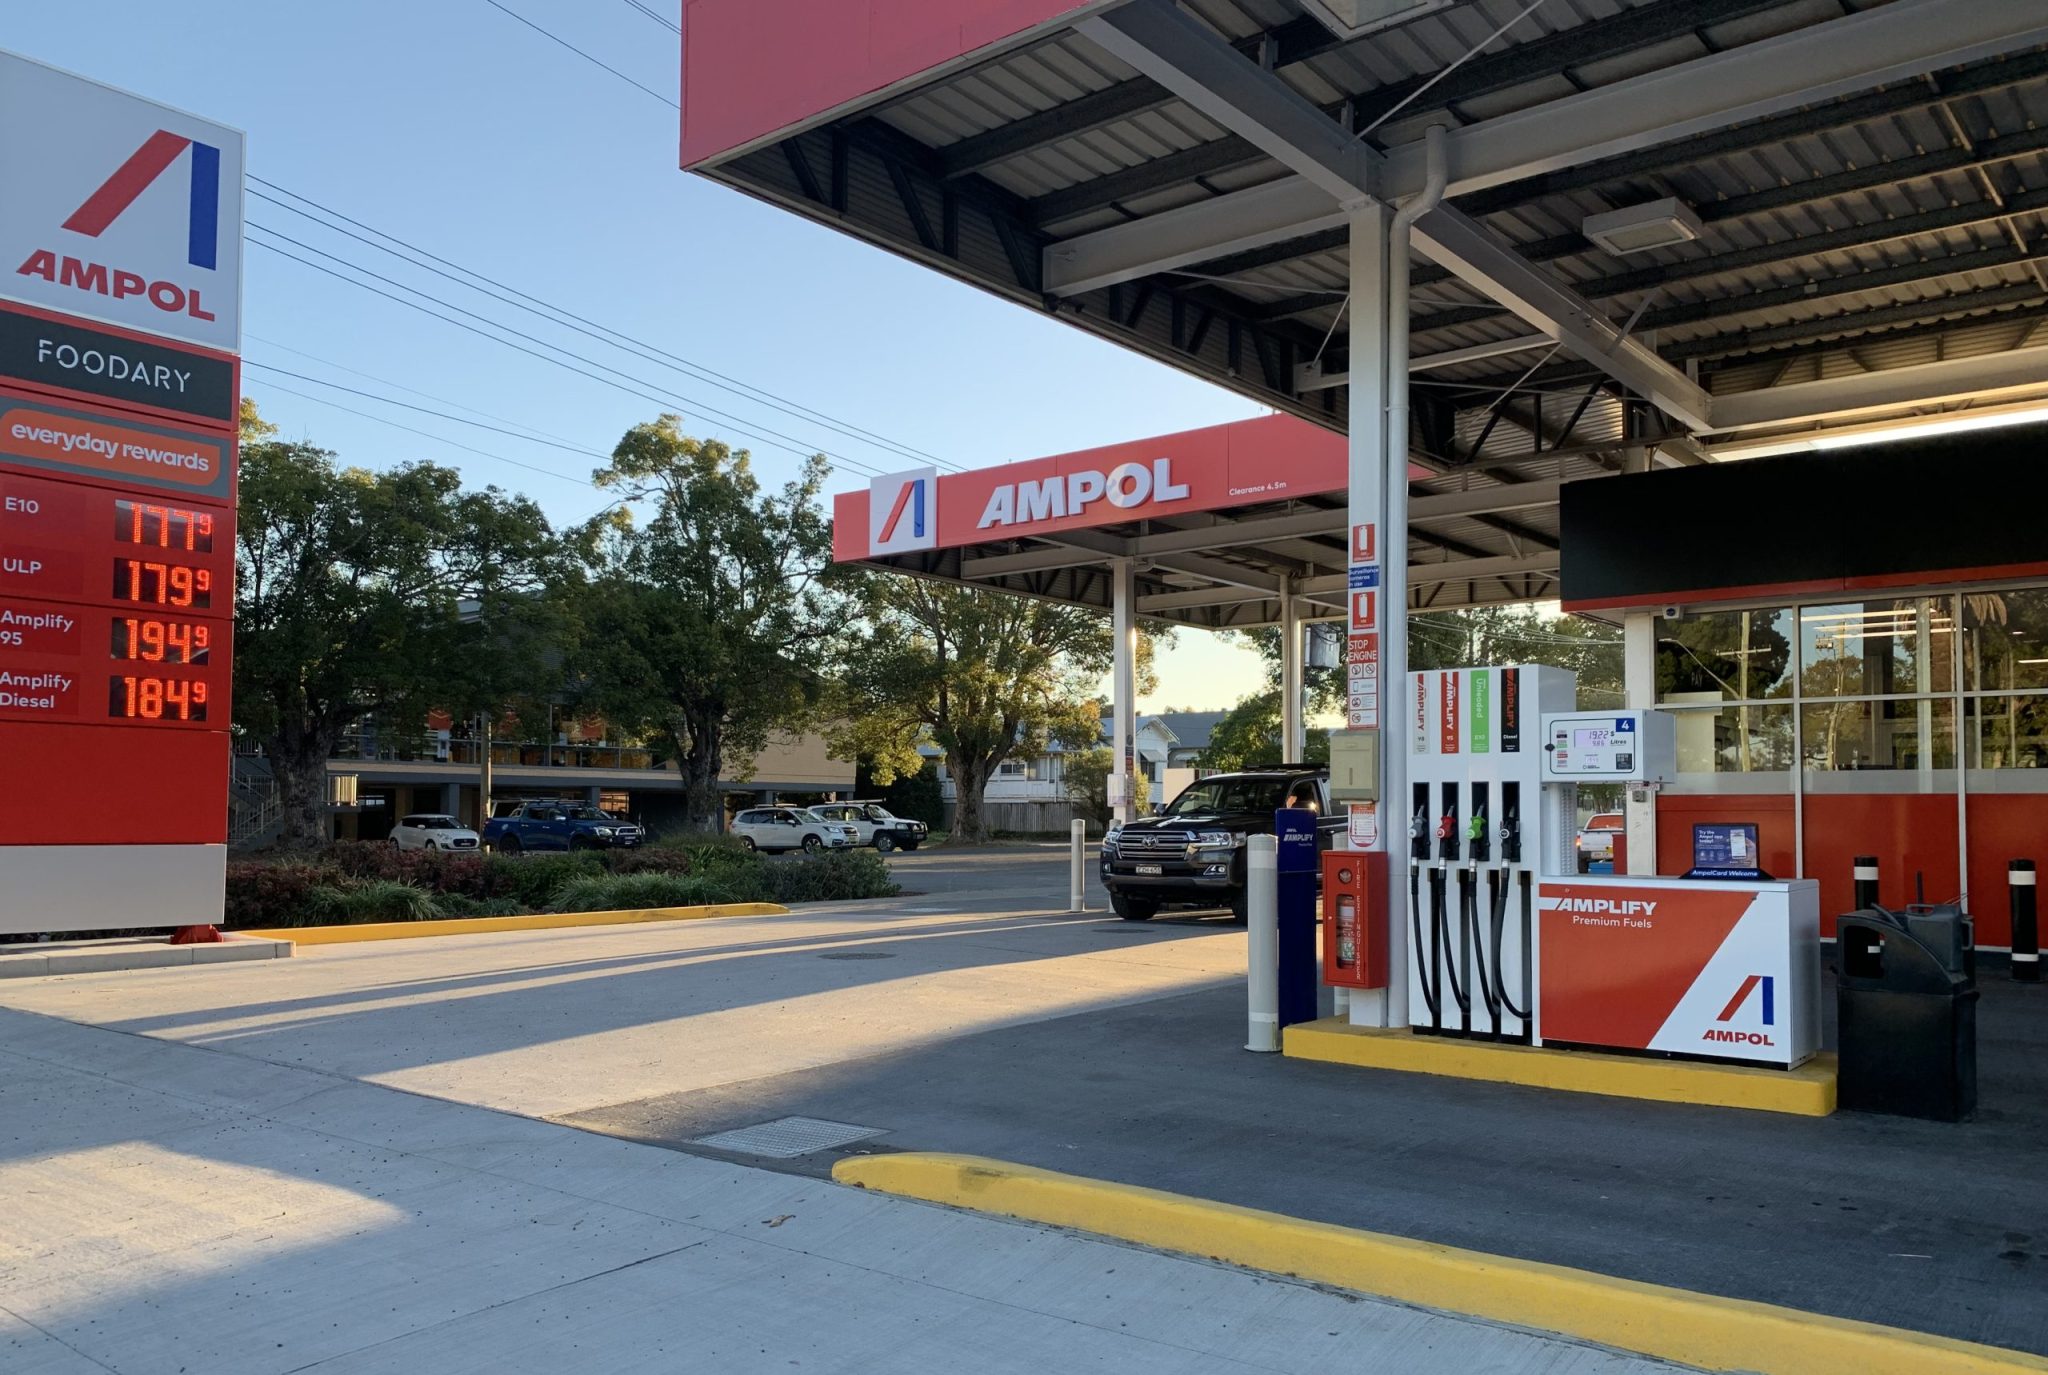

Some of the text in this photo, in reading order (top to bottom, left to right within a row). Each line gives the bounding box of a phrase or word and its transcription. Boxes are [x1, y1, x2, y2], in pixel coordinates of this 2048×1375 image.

[16, 249, 215, 322] AMPOL
[38, 339, 191, 393] FOODARY
[11, 423, 209, 472] everyday rewards
[976, 457, 1189, 530] AMPOL
[1229, 485, 1265, 496] Clearance
[5, 497, 39, 514] E10
[3, 557, 42, 575] ULP
[0, 610, 73, 632] Amplify
[0, 630, 23, 646] 95
[1349, 639, 1368, 650] STOP
[1349, 650, 1377, 661] ENGINE
[0, 671, 72, 692] Amplify
[0, 692, 54, 709] Diesel
[1446, 682, 1454, 731] AMPLIFY
[1475, 677, 1484, 719] Unleaded
[1506, 679, 1515, 728] AMPLIFY
[1417, 683, 1425, 732] AMPLIFY
[1621, 720, 1630, 730] 4
[1556, 898, 1657, 916] AMPLIFY
[1573, 915, 1652, 929] Premium Fuels
[1702, 1029, 1775, 1047] AMPOL
